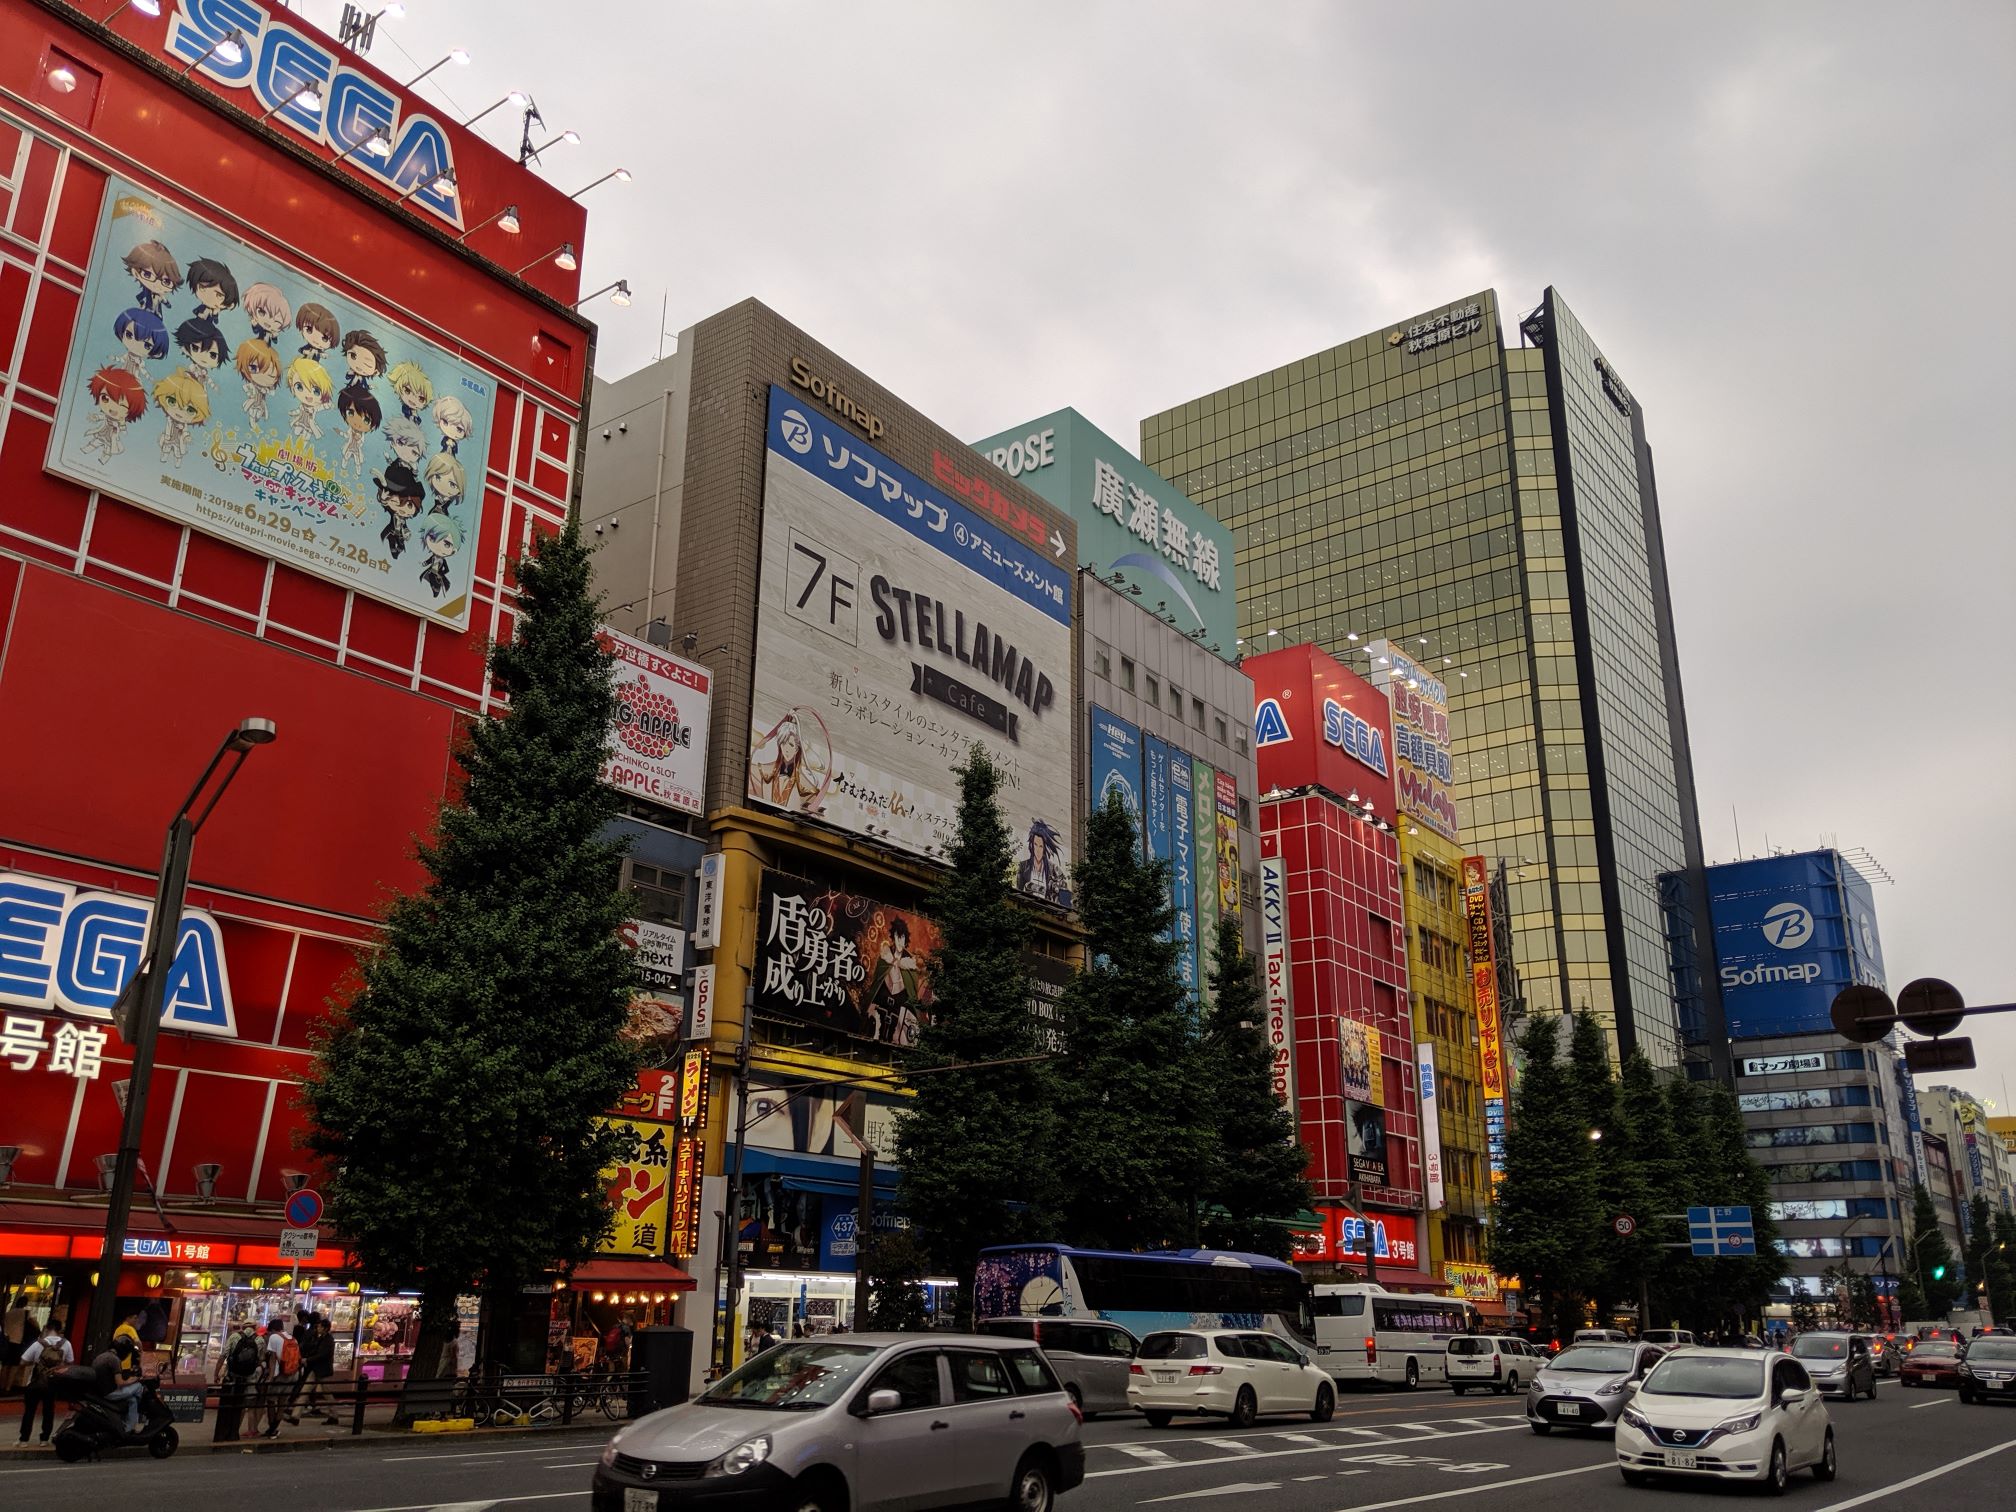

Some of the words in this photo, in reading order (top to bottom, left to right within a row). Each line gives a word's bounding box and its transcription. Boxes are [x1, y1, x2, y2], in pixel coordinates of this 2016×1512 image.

[165, 0, 464, 231] SEGA
[1408, 319, 1481, 354] 秋葉原ビル
[460, 377, 486, 396] SEGA
[789, 355, 885, 440] Sofmap
[821, 432, 949, 533] ソフマップ
[932, 449, 1048, 546] ビックカメラ
[793, 541, 854, 625] 7F
[870, 573, 1054, 717] STELLAMAP
[946, 684, 985, 718] Cafe
[640, 711, 691, 748] APPLE
[1324, 698, 1389, 778] SEGA
[1396, 722, 1453, 785] 高額買取
[656, 767, 677, 779] SLOT
[1262, 865, 1279, 932] AKKY
[1469, 895, 1484, 903] DVD
[642, 928, 677, 944] リアルタイム
[640, 949, 675, 968] next
[1720, 962, 1822, 987] Sofmap
[696, 979, 709, 1024] GPS
[1266, 948, 1288, 1043] Tax-free
[657, 1074, 675, 1117] 2F
[681, 1061, 699, 1114] ラーメン
[1421, 1063, 1434, 1100] SEGA
[682, 1115, 696, 1127] 1F
[1353, 1157, 1366, 1168] SEGA
[1427, 1153, 1440, 1184] 3号館
[834, 1221, 854, 1233] 437
[1618, 1220, 1631, 1231] 50
[176, 1244, 210, 1259] 1号館
[1391, 1240, 1415, 1261] 3号館
